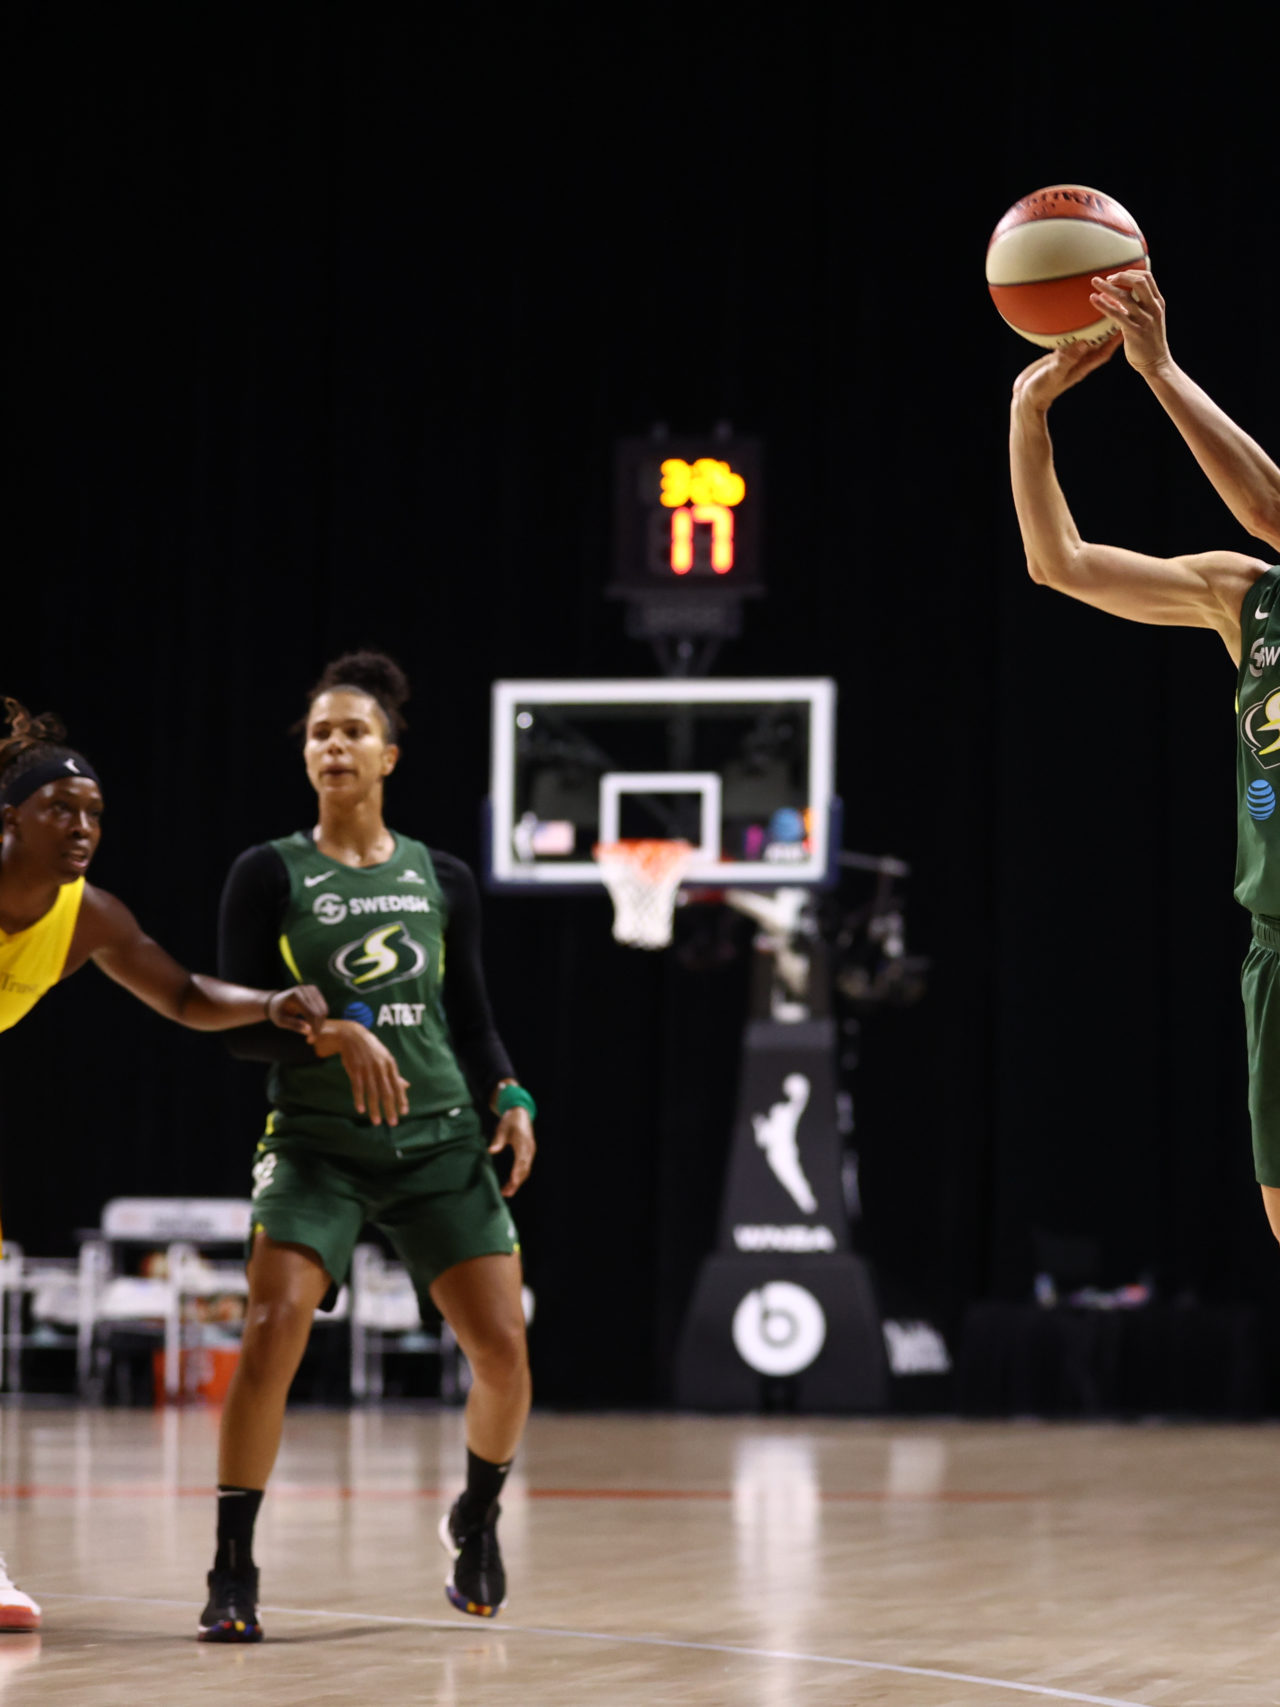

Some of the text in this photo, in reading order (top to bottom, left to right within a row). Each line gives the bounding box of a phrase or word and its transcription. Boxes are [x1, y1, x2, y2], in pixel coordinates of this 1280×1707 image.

[670, 505, 735, 575] 17
[349, 894, 431, 916] SWEDISH
[376, 1002, 427, 1027] AT&T
